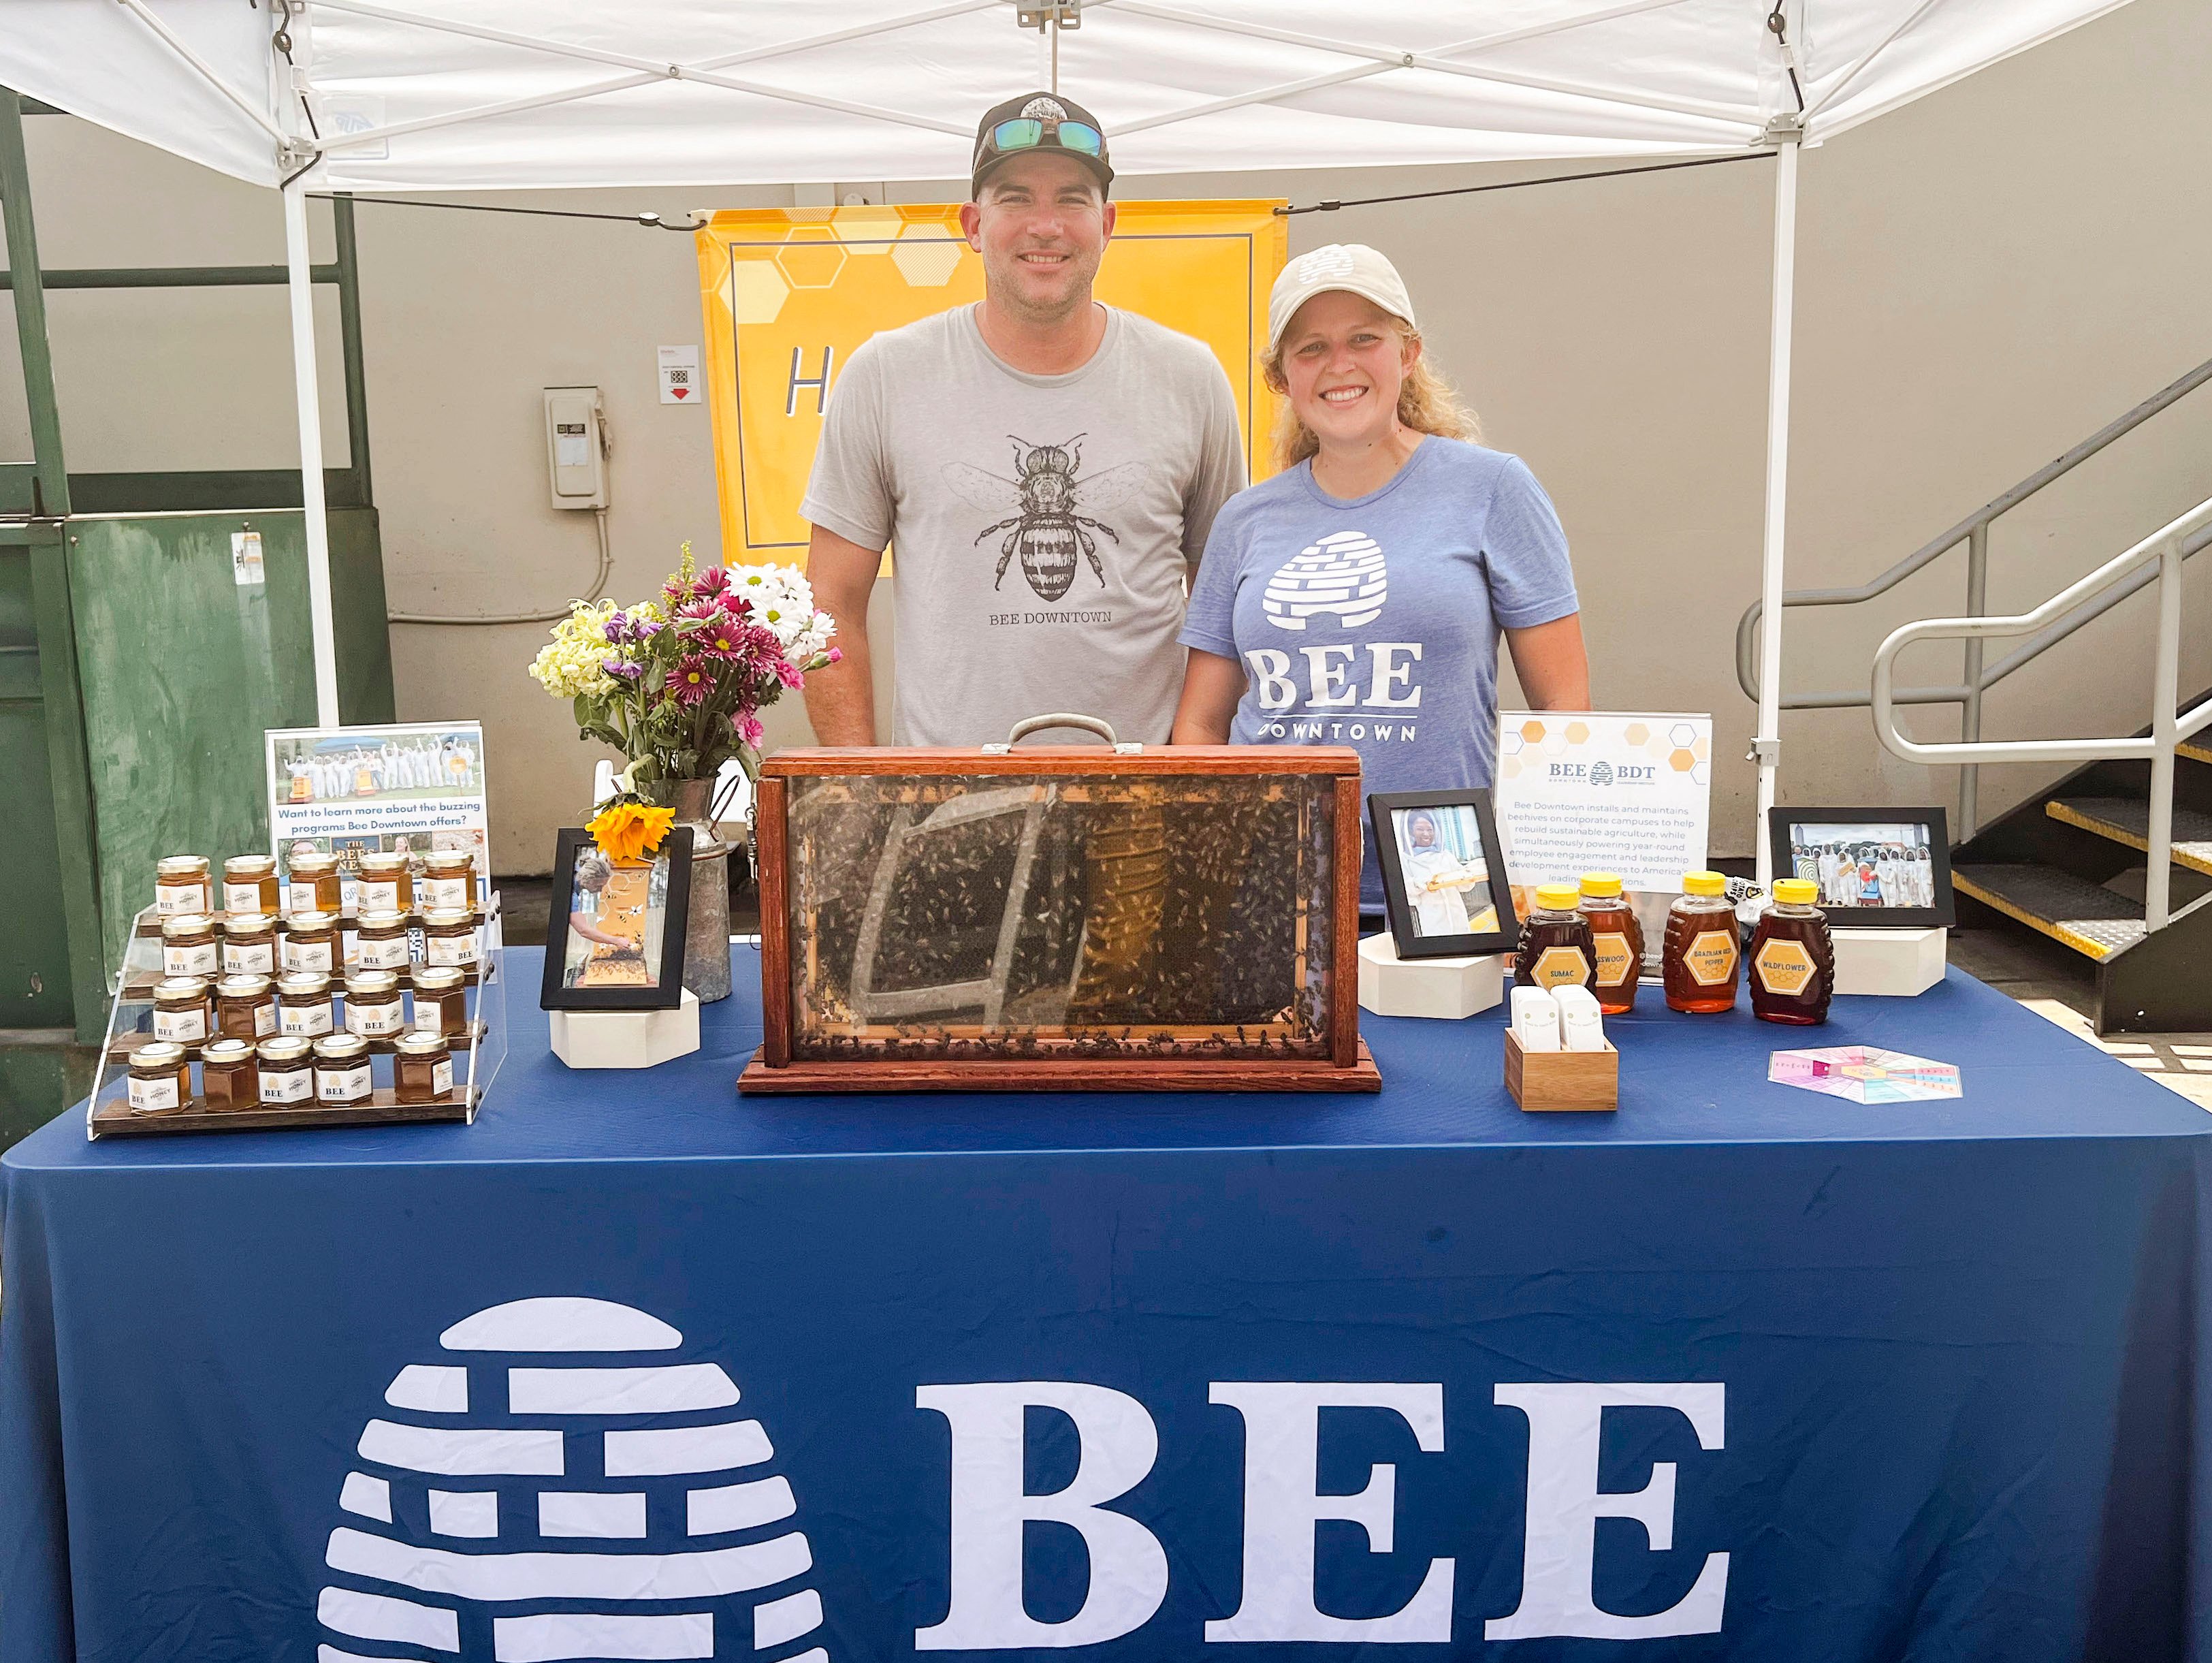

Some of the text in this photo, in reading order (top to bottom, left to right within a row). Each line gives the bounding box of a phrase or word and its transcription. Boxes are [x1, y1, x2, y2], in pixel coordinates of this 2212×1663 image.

[989, 612, 1111, 625] BEE DOWNTOWN
[1244, 642, 1422, 709] BEE
[1550, 763, 1656, 778] BEE BDT
[278, 801, 481, 818] Want to learn more about the buzzing
[1535, 802, 1584, 810] Downtown
[1587, 804, 1618, 812] installs
[291, 815, 467, 835] programs Bee Downtown offers?
[1507, 813, 1548, 822] beehives
[1673, 819, 1694, 828] help
[1550, 827, 1601, 836] sustainable
[1605, 830, 1658, 839] agriculture,
[1514, 838, 1685, 851] simultaneously powering year-round
[1509, 849, 1554, 858] employee
[1557, 853, 1616, 861] engagement
[1640, 854, 1688, 864] leadership
[1509, 861, 1570, 870] development
[1572, 864, 1629, 873] experiences
[372, 891, 390, 900] HONEY
[425, 894, 437, 902] BEE
[442, 888, 460, 897] HONEY
[458, 951, 472, 960] BEE
[1763, 961, 1806, 971] WILDFLOWER
[132, 1095, 145, 1104] BEE
[914, 1381, 1730, 1651] BEE
